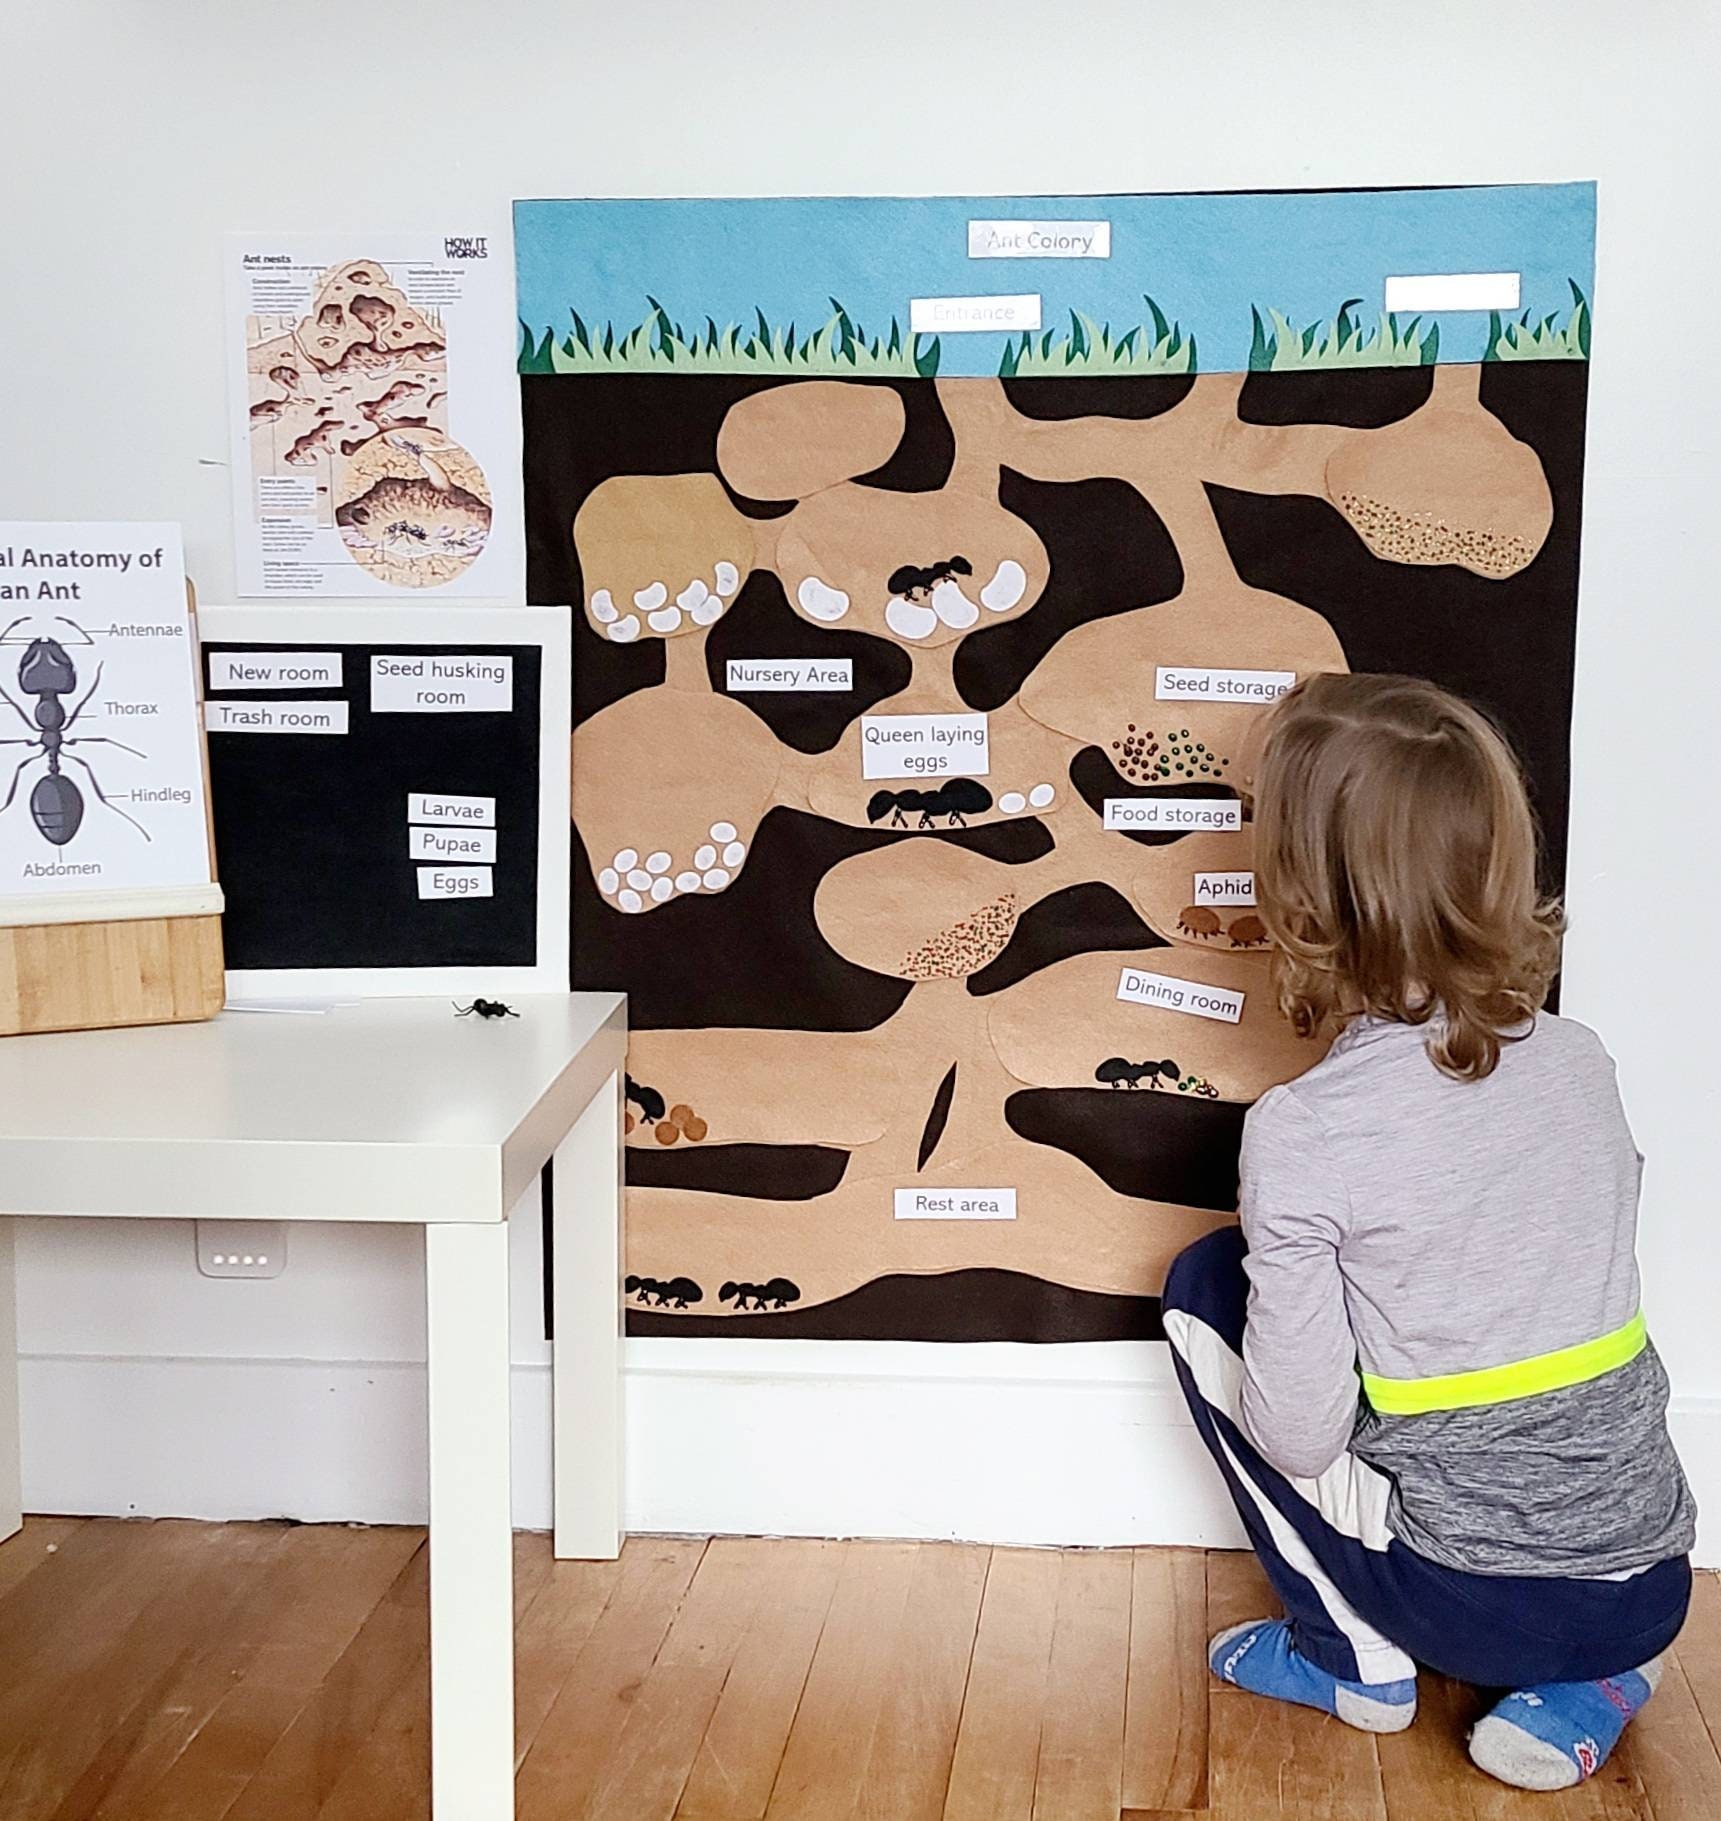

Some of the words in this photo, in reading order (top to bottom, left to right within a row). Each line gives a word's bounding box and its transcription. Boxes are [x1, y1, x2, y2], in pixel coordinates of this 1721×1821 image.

[444, 237, 473, 249] HOW
[475, 237, 488, 250] IT
[987, 231, 1020, 248] Ant
[243, 254, 261, 263] Ant
[263, 255, 292, 263] nests
[445, 248, 488, 259] WORKS
[933, 304, 1015, 321] Entrance
[21, 548, 130, 572] Anatomy
[139, 548, 164, 568] of
[0, 585, 30, 600] an
[37, 580, 81, 600] Ant
[109, 624, 184, 637] Antennae
[229, 663, 272, 680] New
[278, 666, 329, 681] room
[376, 660, 424, 677] Seed
[432, 662, 505, 683] husking
[730, 665, 800, 686] Nursery
[806, 667, 849, 683] Area
[1163, 674, 1210, 692] Seed
[1216, 678, 1288, 701] storage
[416, 691, 466, 705] room
[104, 701, 159, 716] Thorax
[219, 707, 273, 725] Trash
[280, 713, 331, 727] room
[865, 726, 924, 745] Queen
[931, 726, 985, 746] laying
[903, 755, 948, 773] eggs
[131, 788, 191, 804] Hindleg
[422, 799, 484, 819] Larvae
[1111, 805, 1158, 822] Food
[1165, 808, 1236, 827] storage
[423, 833, 481, 855] Pupae
[23, 862, 101, 877] Abdomen
[433, 873, 479, 893] Eggs
[1198, 878, 1252, 899] Aphid
[1125, 976, 1184, 1006] Dining
[1190, 994, 1237, 1015] room
[916, 1195, 954, 1211] Rest
[960, 1200, 999, 1212] area
